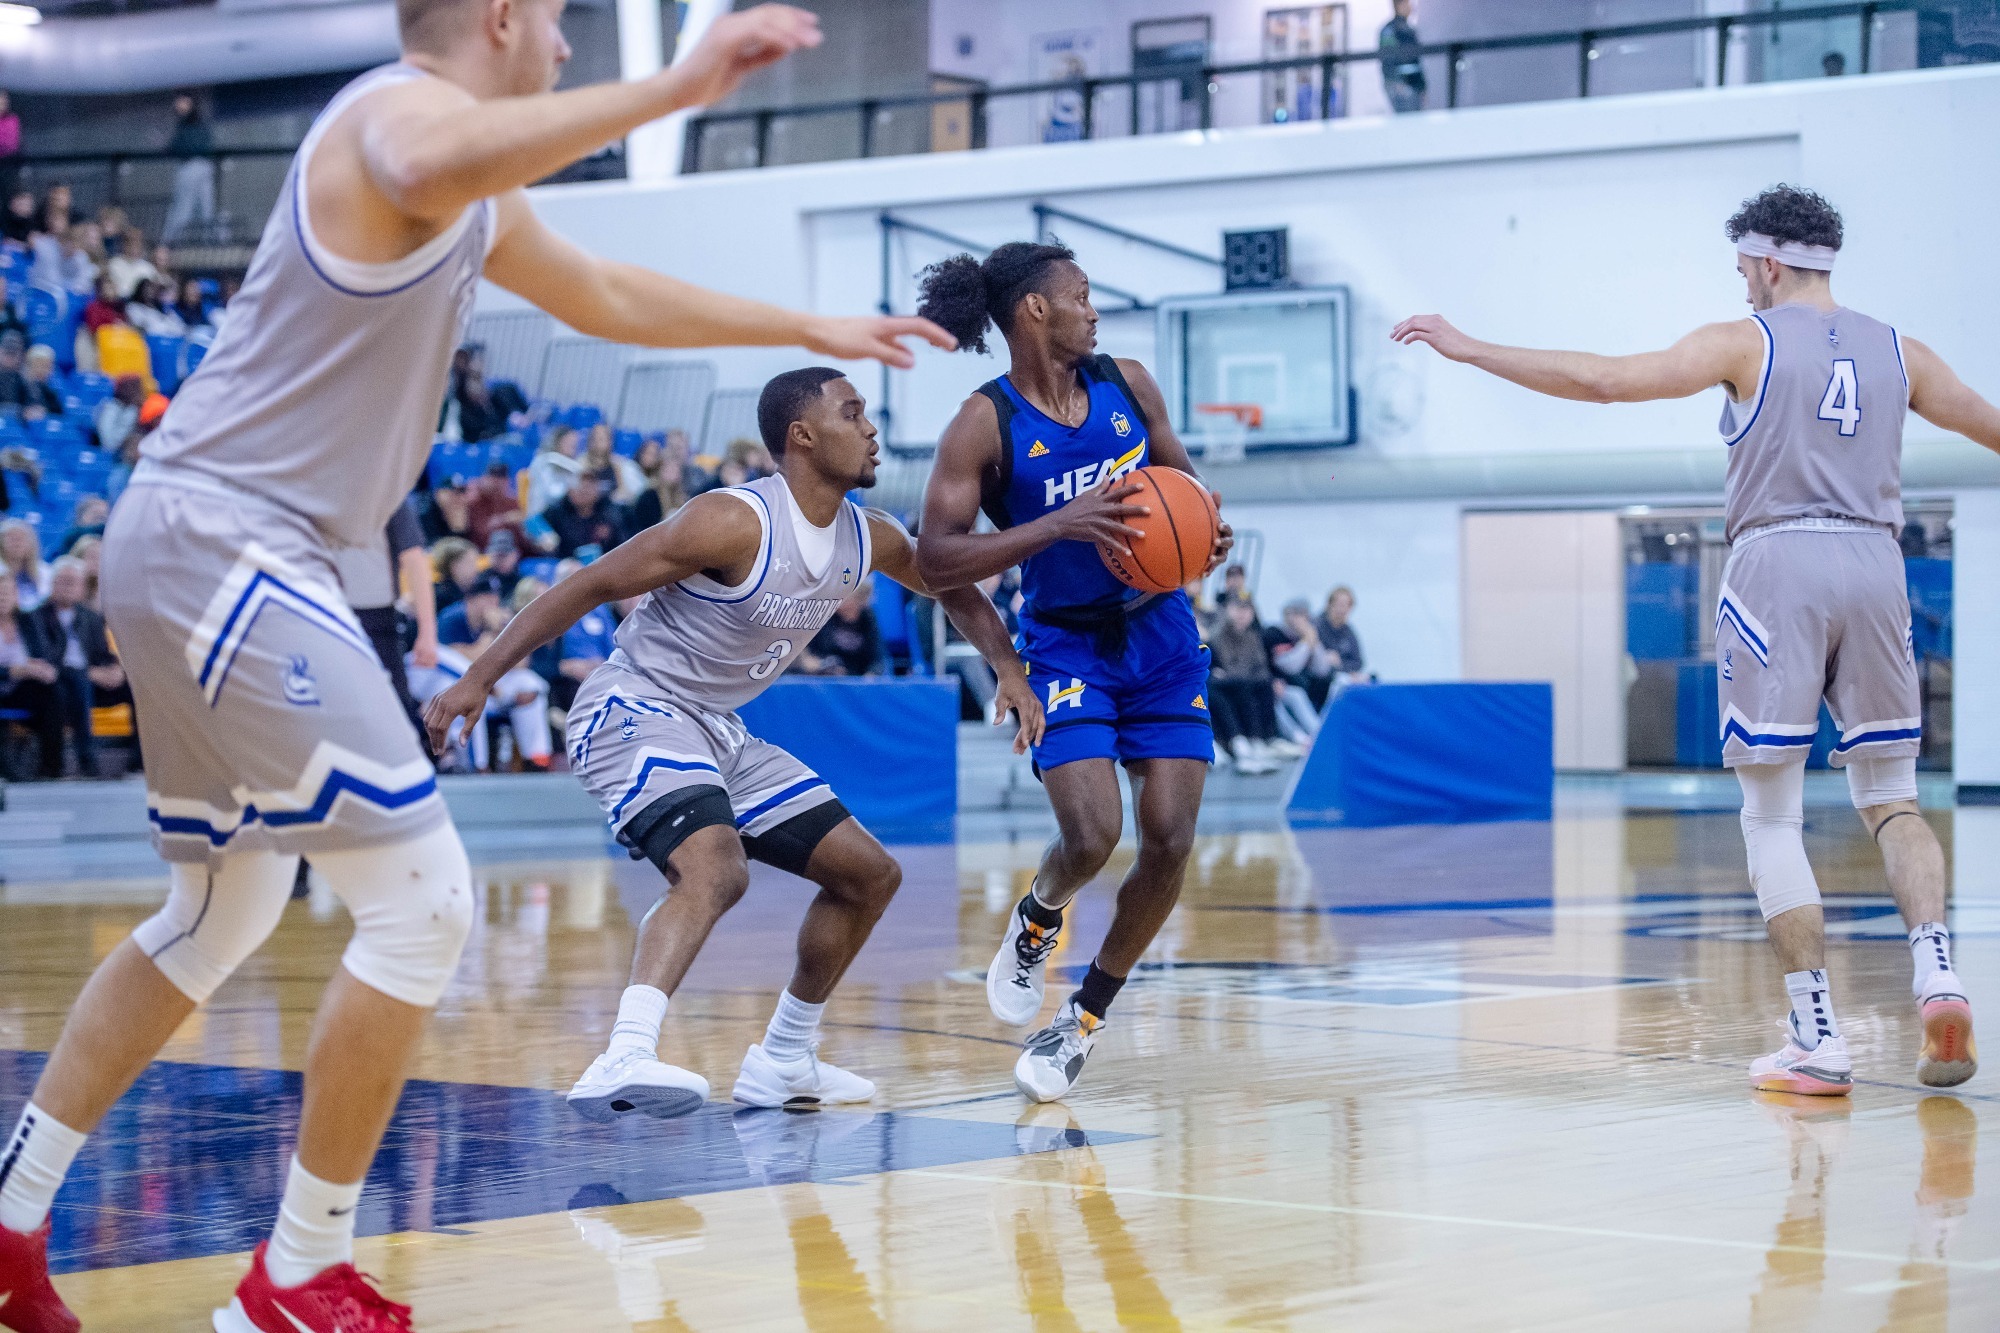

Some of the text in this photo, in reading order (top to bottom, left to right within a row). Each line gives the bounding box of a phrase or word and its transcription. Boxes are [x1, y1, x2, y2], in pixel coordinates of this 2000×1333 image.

[1817, 359, 1862, 436] 4
[747, 639, 793, 681] 3
[1046, 677, 1087, 715] H
